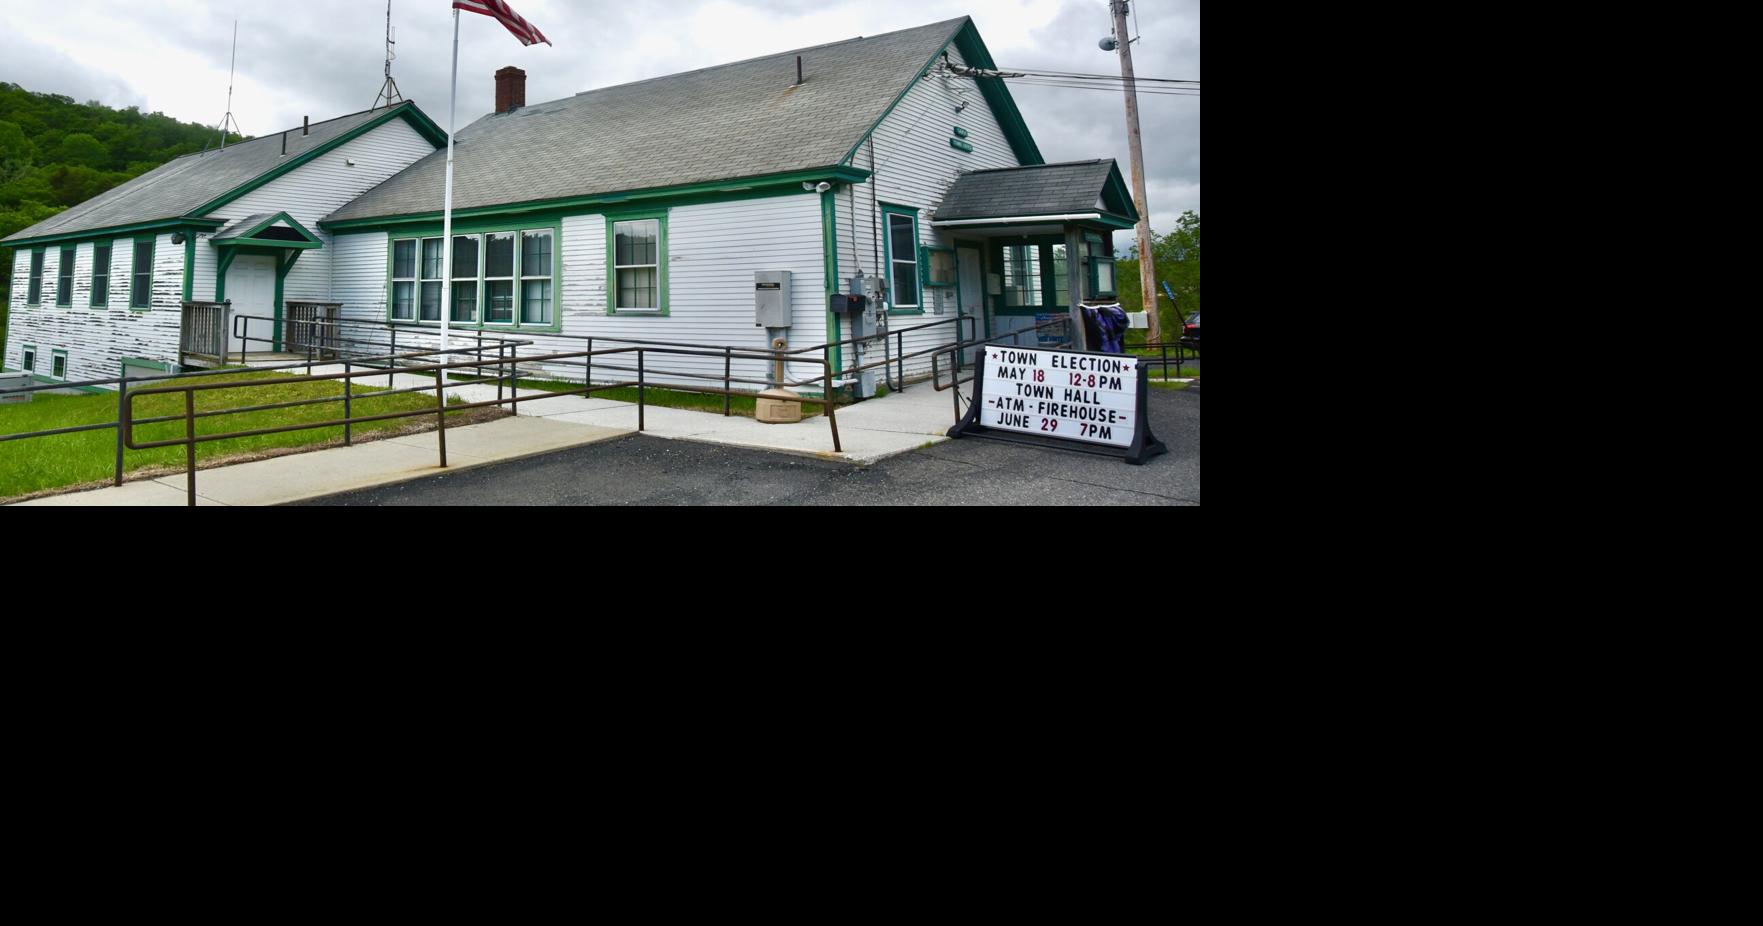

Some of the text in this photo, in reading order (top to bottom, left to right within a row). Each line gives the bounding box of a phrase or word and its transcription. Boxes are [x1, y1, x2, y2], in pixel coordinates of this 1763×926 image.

[1000, 350, 1121, 374] TOWN ELECTION
[997, 365, 1026, 380] MAY
[1032, 368, 1045, 383] 18
[1016, 382, 1101, 405] TOWN HALL
[997, 412, 1030, 428] JUNE
[1040, 417, 1058, 432] 29
